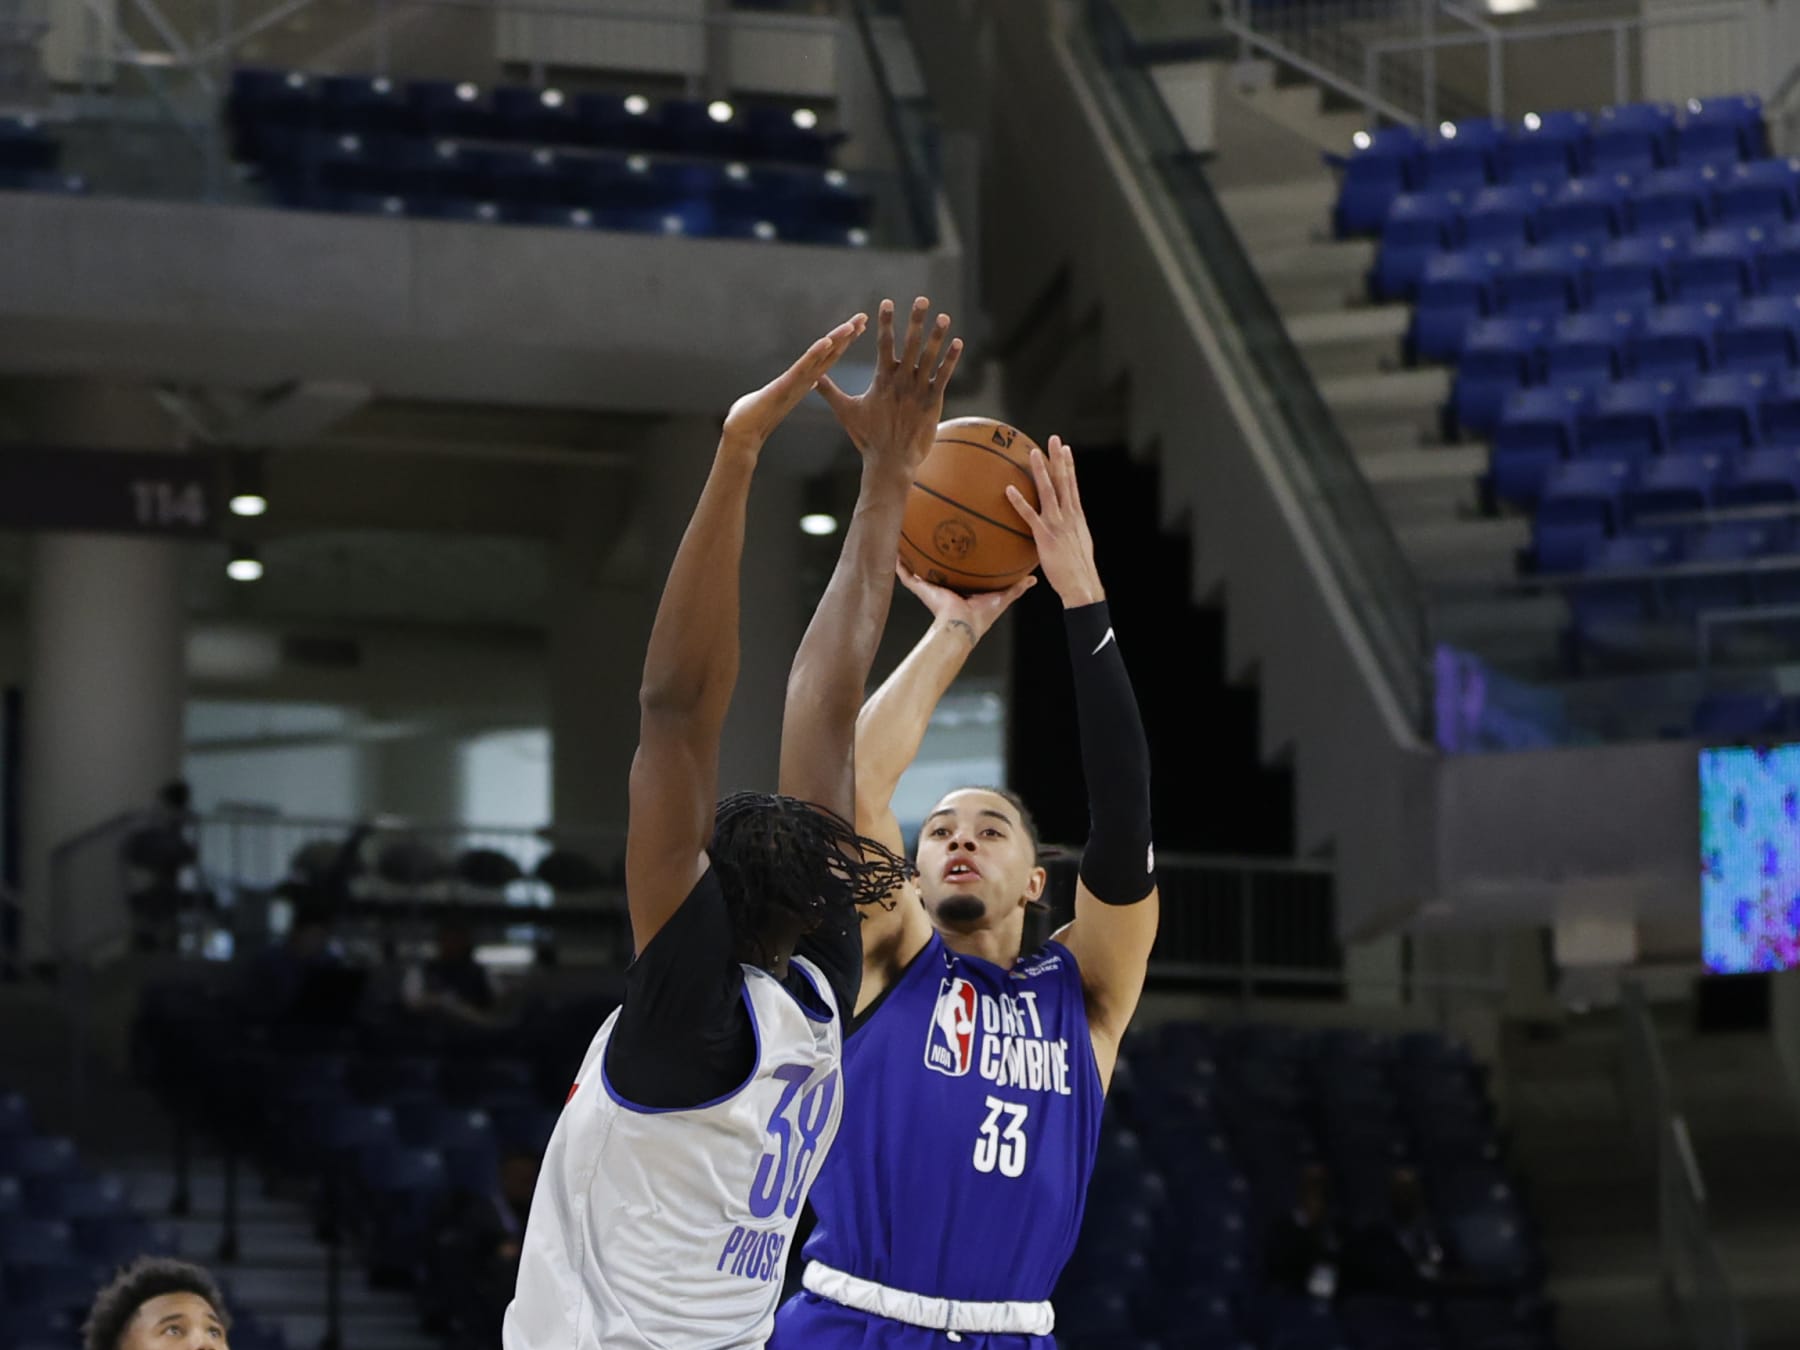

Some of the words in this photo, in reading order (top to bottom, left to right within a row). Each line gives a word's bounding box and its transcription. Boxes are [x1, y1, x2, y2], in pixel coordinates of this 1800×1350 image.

[131, 481, 207, 525] 114
[749, 1063, 838, 1219] 38
[973, 1094, 1028, 1178] 33
